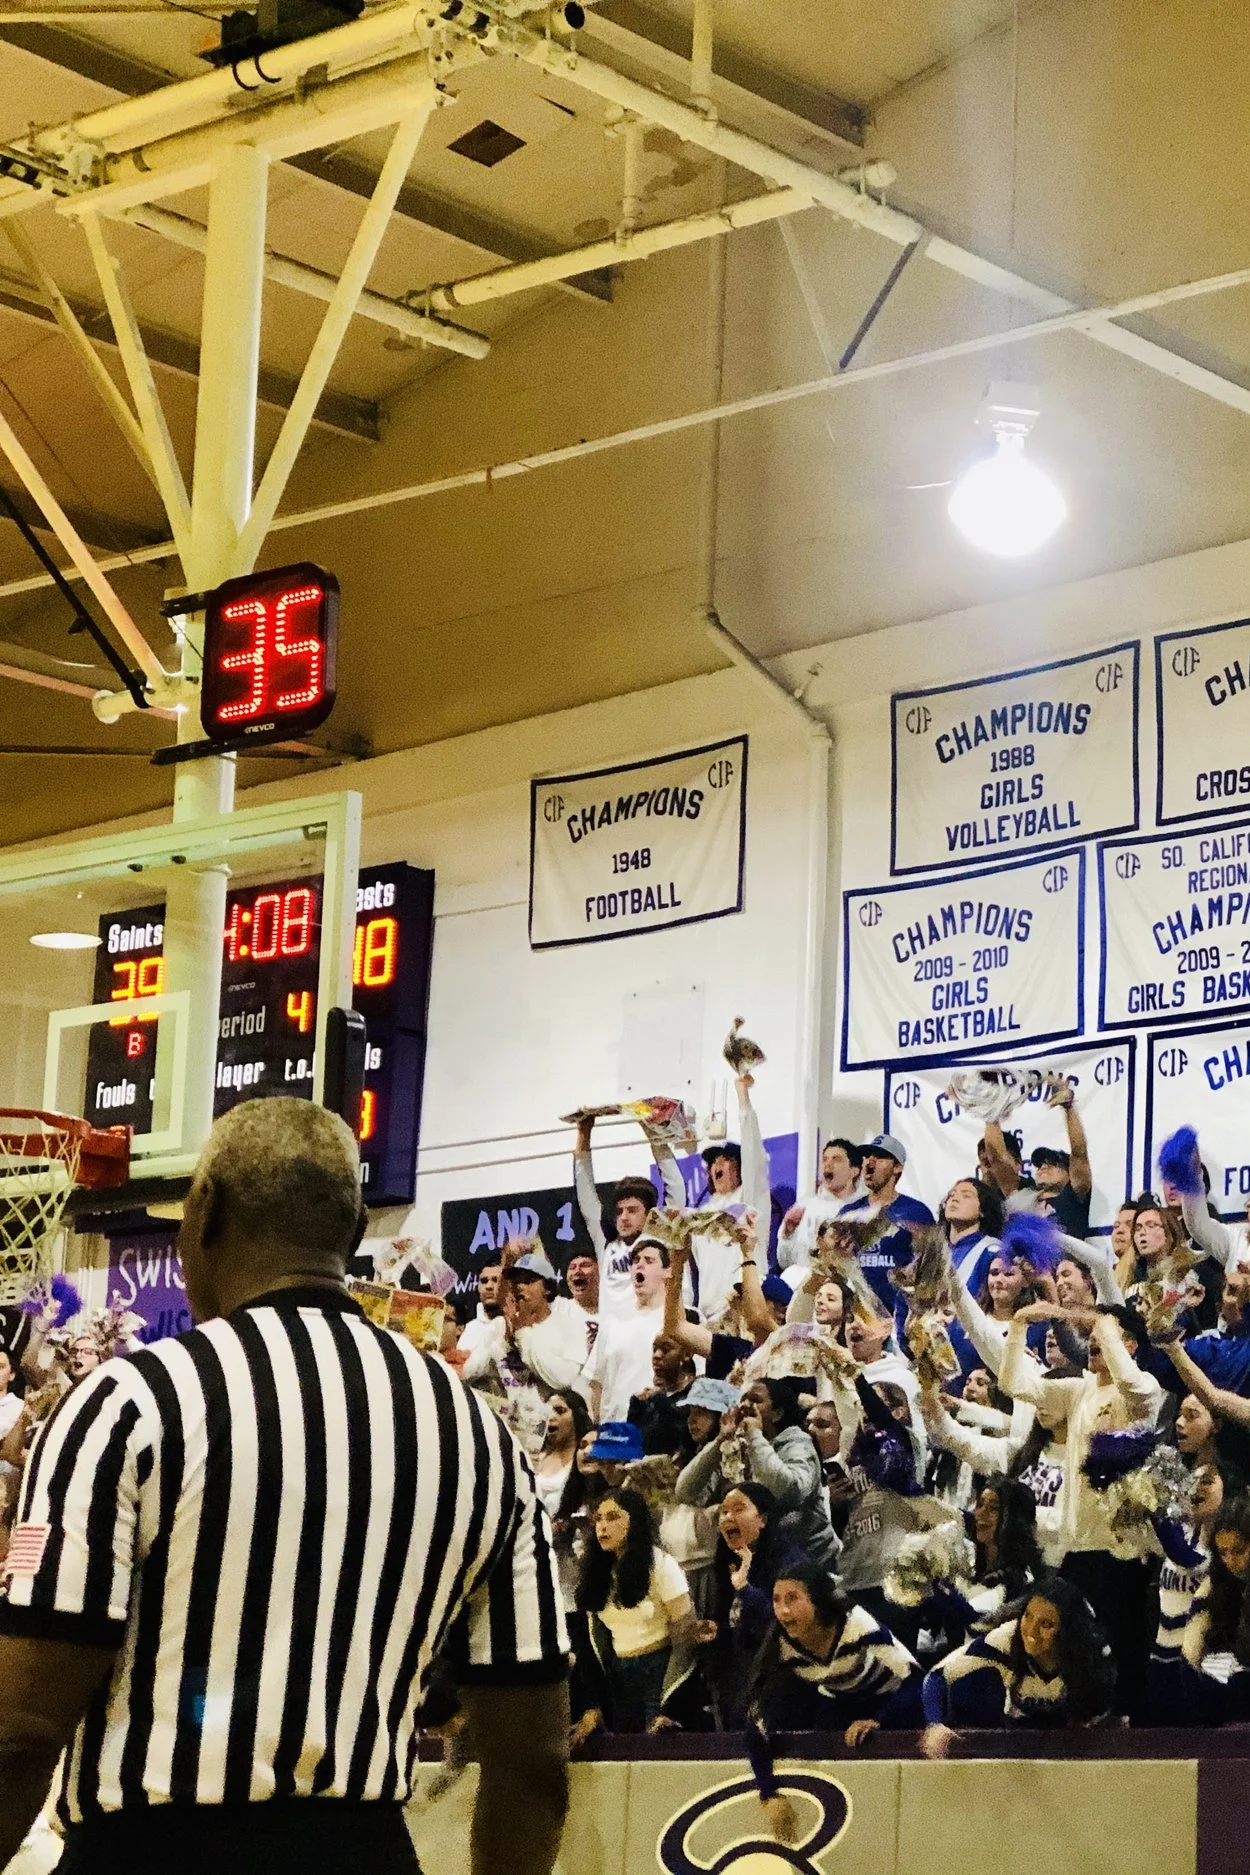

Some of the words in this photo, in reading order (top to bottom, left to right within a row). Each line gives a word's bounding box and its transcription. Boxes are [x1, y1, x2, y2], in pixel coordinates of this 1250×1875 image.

[219, 588, 320, 719] 35
[1172, 647, 1200, 677] CIF
[1096, 663, 1123, 692] CIF
[906, 706, 932, 734] CIF
[935, 701, 1091, 764] CHAMPIONS
[991, 745, 1034, 772] 1988
[708, 760, 733, 788] CIF
[981, 774, 1043, 809] GIRLS
[544, 795, 565, 822] CIF
[567, 787, 704, 843] CHAMPIONS
[945, 801, 1081, 851] VOLLEYBALL
[613, 848, 651, 873] 1948
[1116, 852, 1141, 879] CIF
[1160, 845, 1186, 870] SO.
[1043, 866, 1068, 893] CIF
[586, 882, 681, 922] FOOTBALL
[859, 901, 882, 927] CIF
[107, 923, 164, 954] Saints
[891, 901, 1034, 964] CHAMPIONS
[914, 956, 953, 982] 2009
[971, 949, 1009, 973] 2010
[1178, 946, 1220, 974] 2009
[287, 991, 308, 1033] 4
[931, 984, 990, 1012] GIRLS
[1128, 981, 1185, 1013] GIRLS
[221, 1005, 266, 1038] eriod
[899, 1005, 1020, 1047] BASKETBALL
[216, 1061, 266, 1092] layer
[1094, 1057, 1124, 1085] CIF
[1158, 1049, 1188, 1077] CIF
[96, 1079, 136, 1109] fouls
[894, 1082, 920, 1108] CIF
[469, 1207, 540, 1254] AND
[556, 1202, 575, 1242] 1
